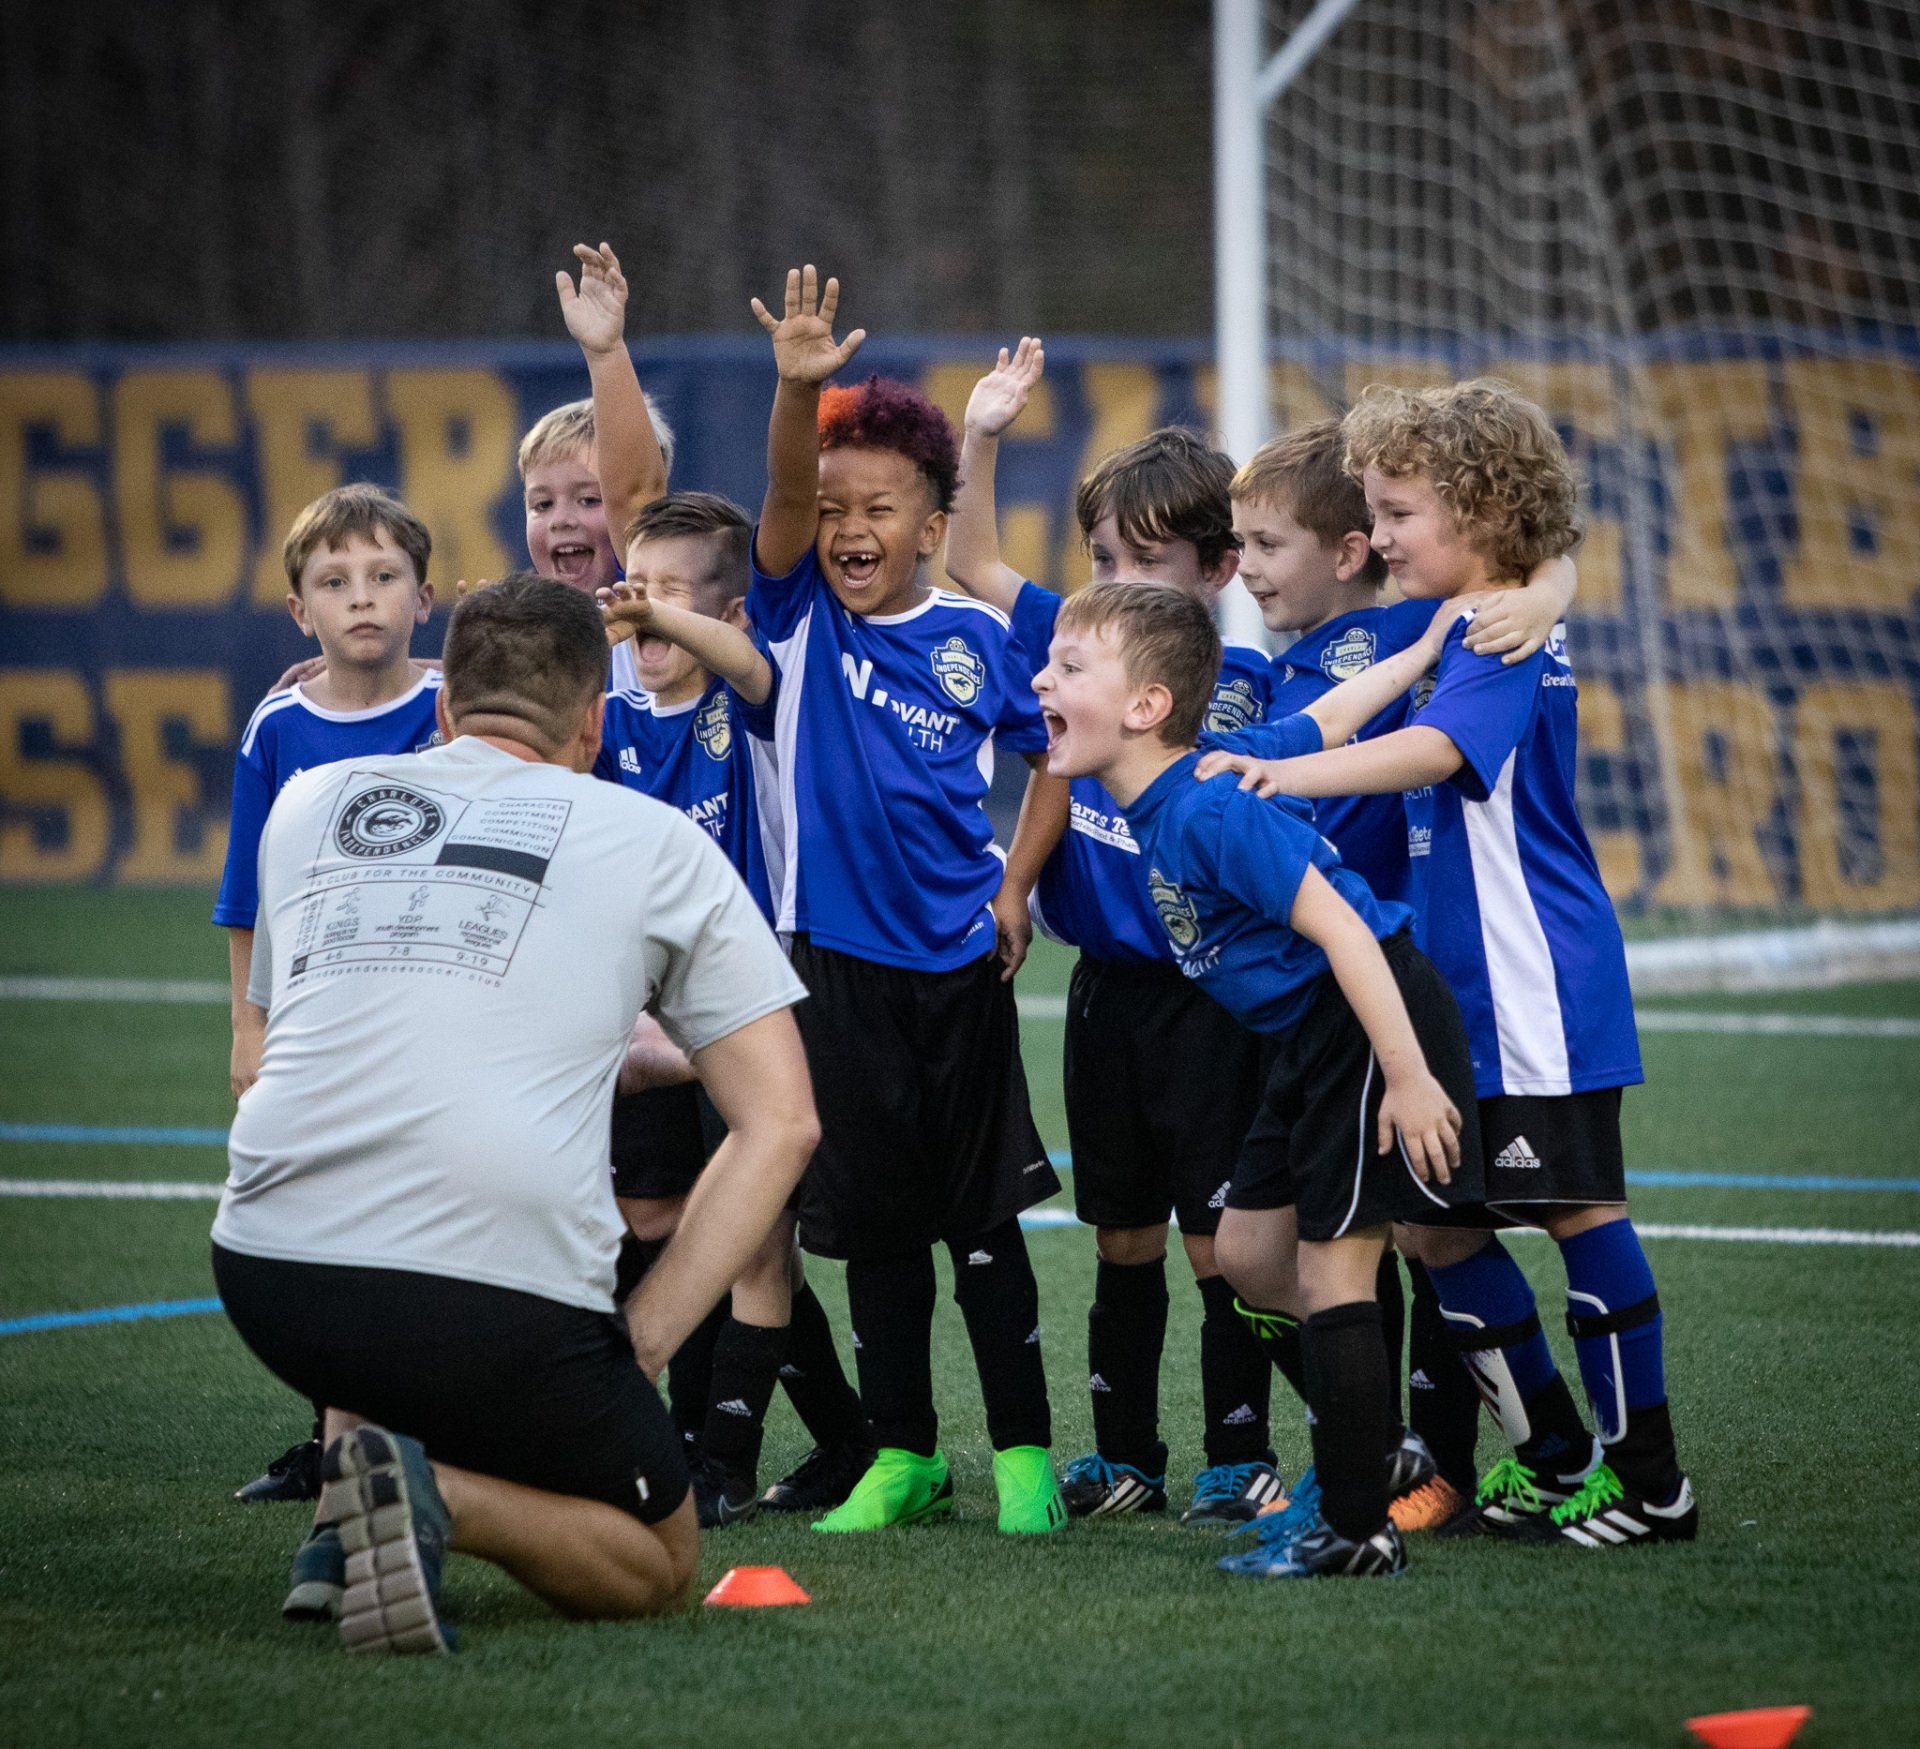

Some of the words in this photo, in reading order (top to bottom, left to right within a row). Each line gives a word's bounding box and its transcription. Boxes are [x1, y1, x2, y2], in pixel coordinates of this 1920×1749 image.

[891, 700, 960, 735] VANT
[356, 789, 438, 820] CHARLOTTE
[499, 802, 567, 811] CHARACTER
[484, 810, 563, 821] COMMITMENT
[480, 818, 558, 834] COMPETITION
[483, 827, 555, 843] COMMUNITY
[340, 829, 428, 858] INDEPENDENCE
[451, 834, 550, 854] COMMUNICATION
[327, 871, 358, 885] CLUB
[364, 869, 393, 878] FOR
[401, 869, 429, 878] THE
[435, 869, 532, 894] COMMUNITY
[458, 919, 509, 941] LEAGUES
[388, 945, 411, 957] 7-8
[1494, 1156, 1541, 1169] adidas
